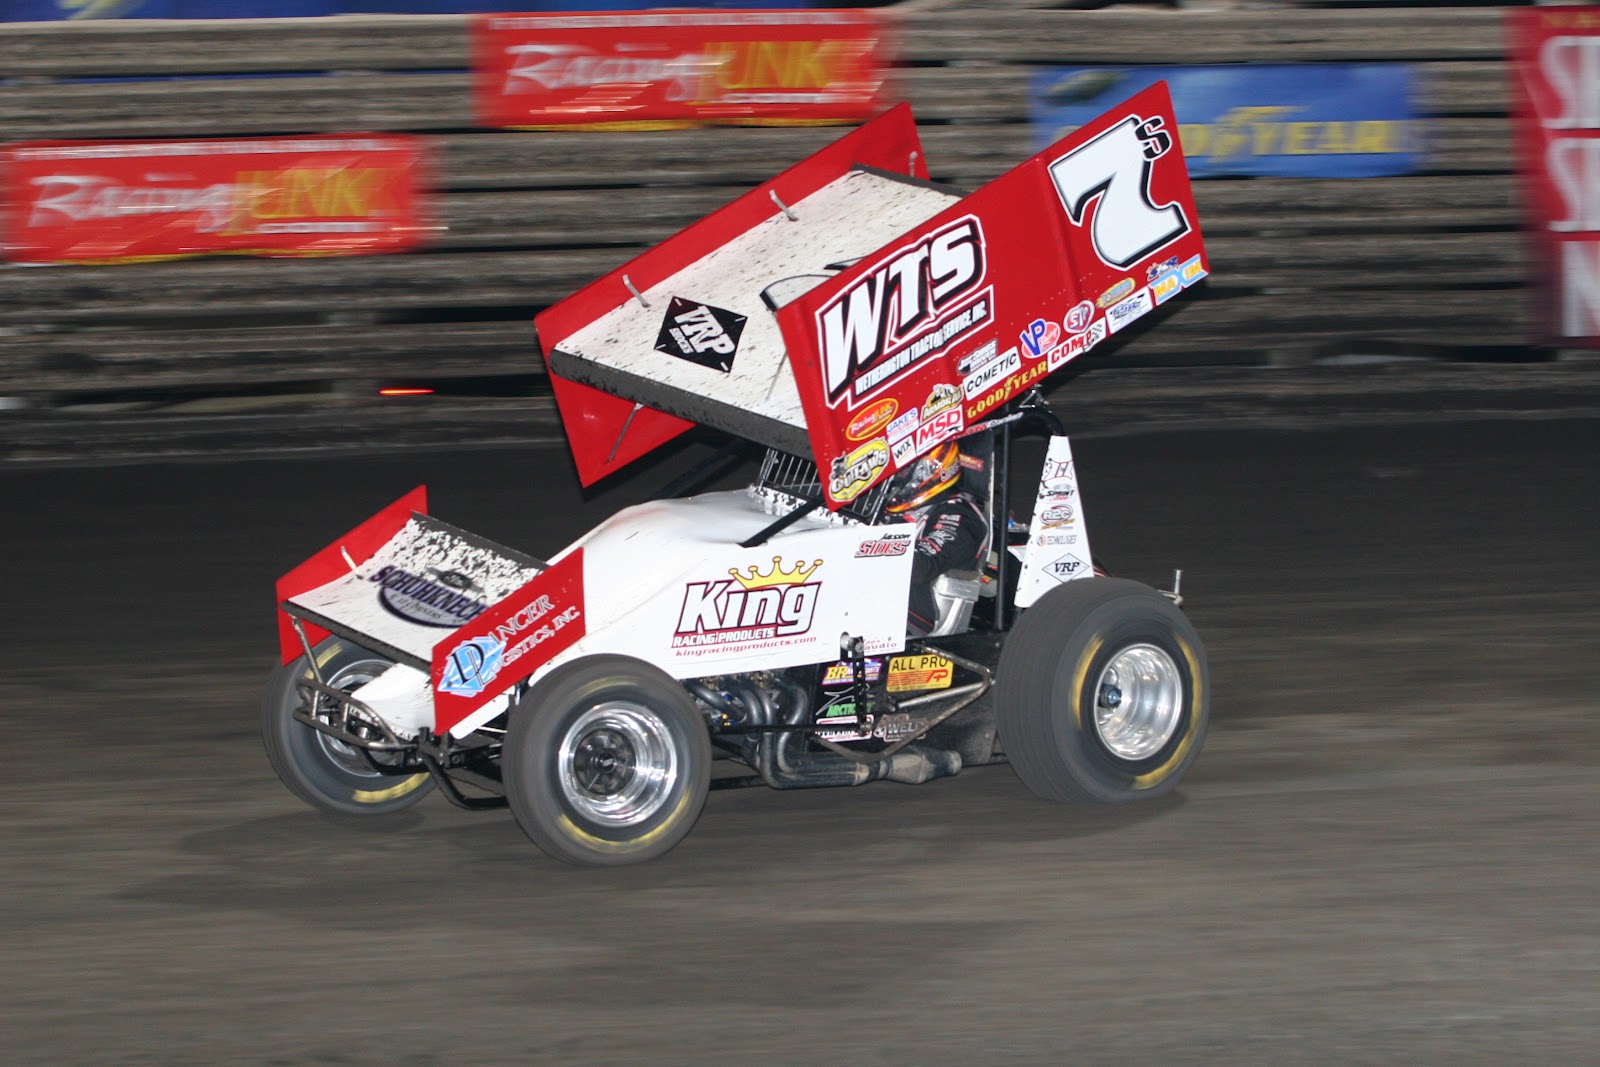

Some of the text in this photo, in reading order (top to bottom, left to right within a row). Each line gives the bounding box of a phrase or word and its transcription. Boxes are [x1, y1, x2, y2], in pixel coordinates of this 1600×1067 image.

[1152, 260, 1202, 300] MAXIM
[822, 221, 980, 398] WTS
[1068, 304, 1090, 328] STP
[674, 305, 735, 354] VRP
[1020, 320, 1045, 356] VP
[1050, 330, 1092, 364] COMP
[966, 352, 1018, 393] COMETIC
[966, 360, 1048, 419] GOODYEAR
[918, 410, 961, 446] MSD
[893, 440, 912, 459] WIX
[854, 540, 911, 559] SIDES
[1054, 561, 1080, 573] VRP
[674, 579, 823, 637] King
[672, 627, 775, 648] RACING PRODUCTS
[675, 636, 817, 657] kingracingproducts.com
[891, 658, 915, 672] ALL
[920, 655, 948, 669] PRO
